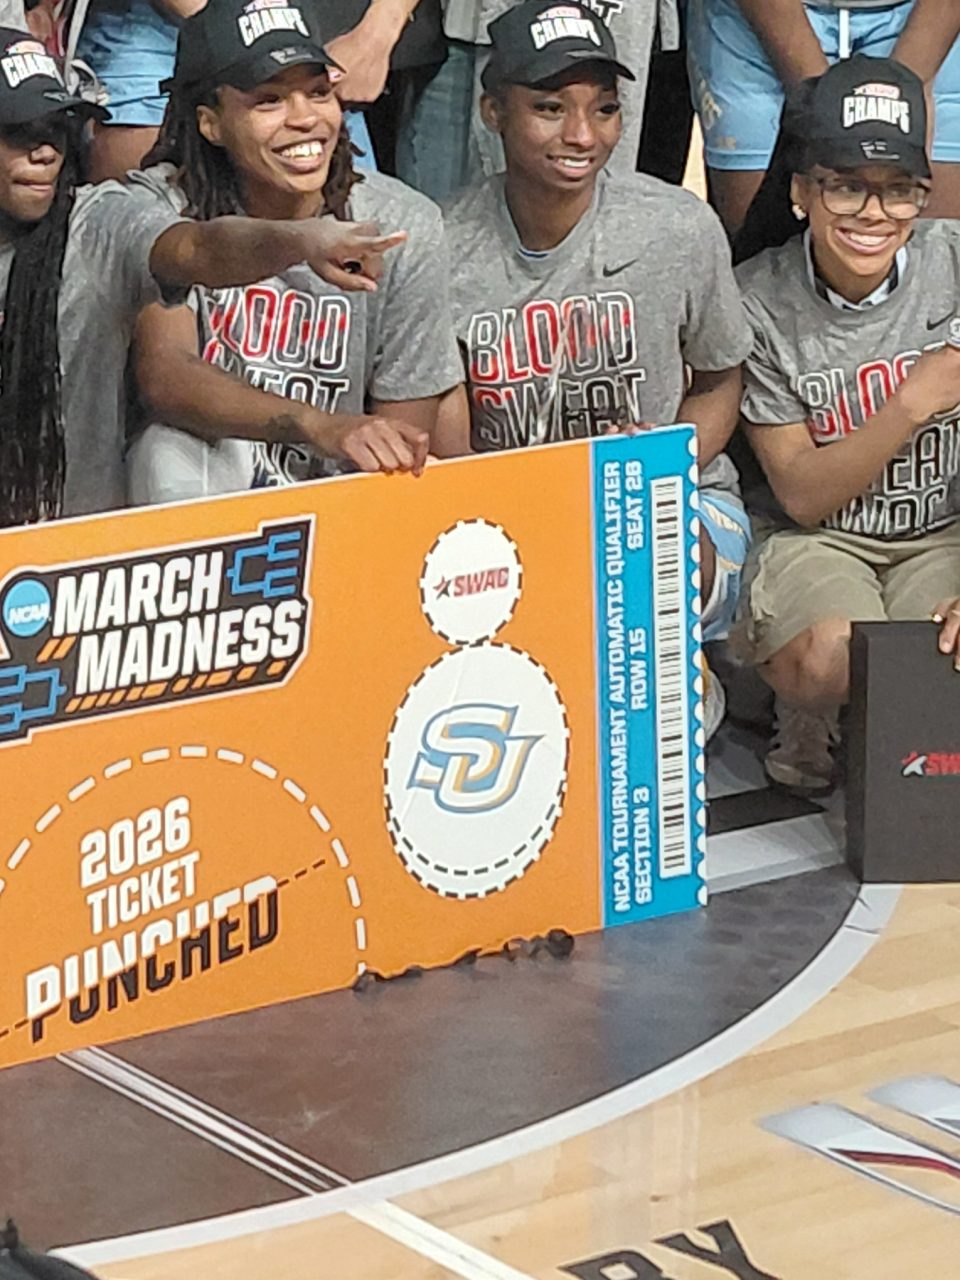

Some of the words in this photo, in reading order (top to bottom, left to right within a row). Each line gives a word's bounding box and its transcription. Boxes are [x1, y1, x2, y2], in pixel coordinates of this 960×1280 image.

[843, 96, 909, 133] CHAMPS
[468, 291, 637, 385] BLOOD
[604, 461, 625, 576] QUALIFIER
[626, 495, 643, 550] SEAT
[7, 603, 50, 626] NCAA
[52, 550, 224, 637] MARCH
[454, 567, 509, 597] SWAC
[73, 599, 304, 696] MADNESS
[607, 579, 626, 704] AUTOMATIC
[629, 628, 646, 655] 15
[630, 660, 648, 711] ROW
[406, 703, 545, 813] SU
[609, 707, 629, 852] TOURNAMENT
[633, 786, 649, 803] 3
[80, 796, 190, 888] 2026
[613, 851, 631, 912] NCAA
[634, 807, 653, 906] SECTION
[87, 851, 200, 934] TICKET
[25, 875, 279, 1043] PUNCHED
